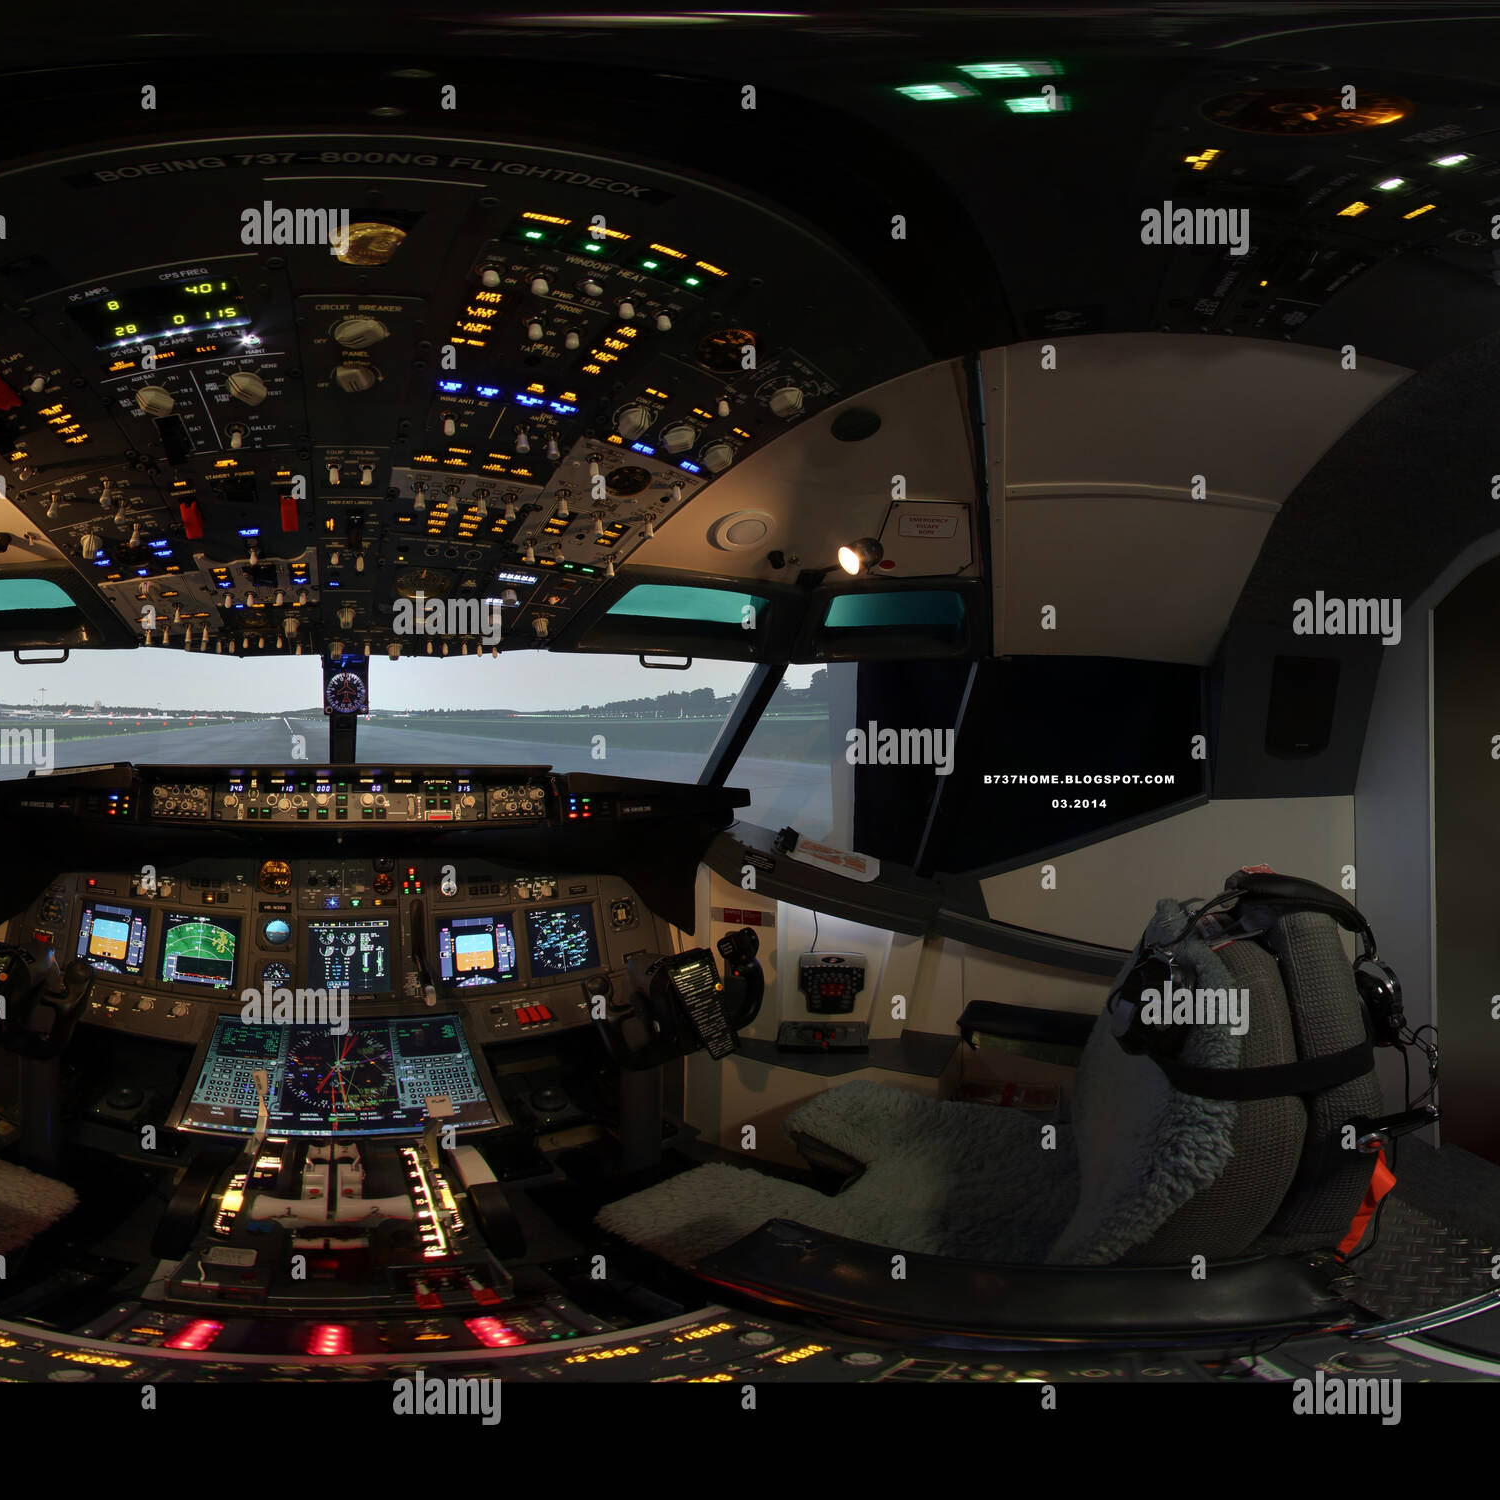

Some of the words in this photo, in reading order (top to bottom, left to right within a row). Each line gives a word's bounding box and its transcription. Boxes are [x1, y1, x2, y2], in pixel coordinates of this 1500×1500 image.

[94, 156, 228, 183] BOEING
[232, 151, 440, 167] 737-800NG
[449, 157, 651, 199] FLIGHTDECK
[565, 255, 613, 272] WINDOW
[617, 270, 646, 283] HEAT
[185, 282, 228, 295] 401
[106, 300, 121, 311] 8
[358, 304, 403, 312] BREAKER
[173, 314, 186, 325] 0
[205, 307, 237, 320] 115
[115, 324, 138, 336] 28
[370, 1206, 380, 1215] 2
